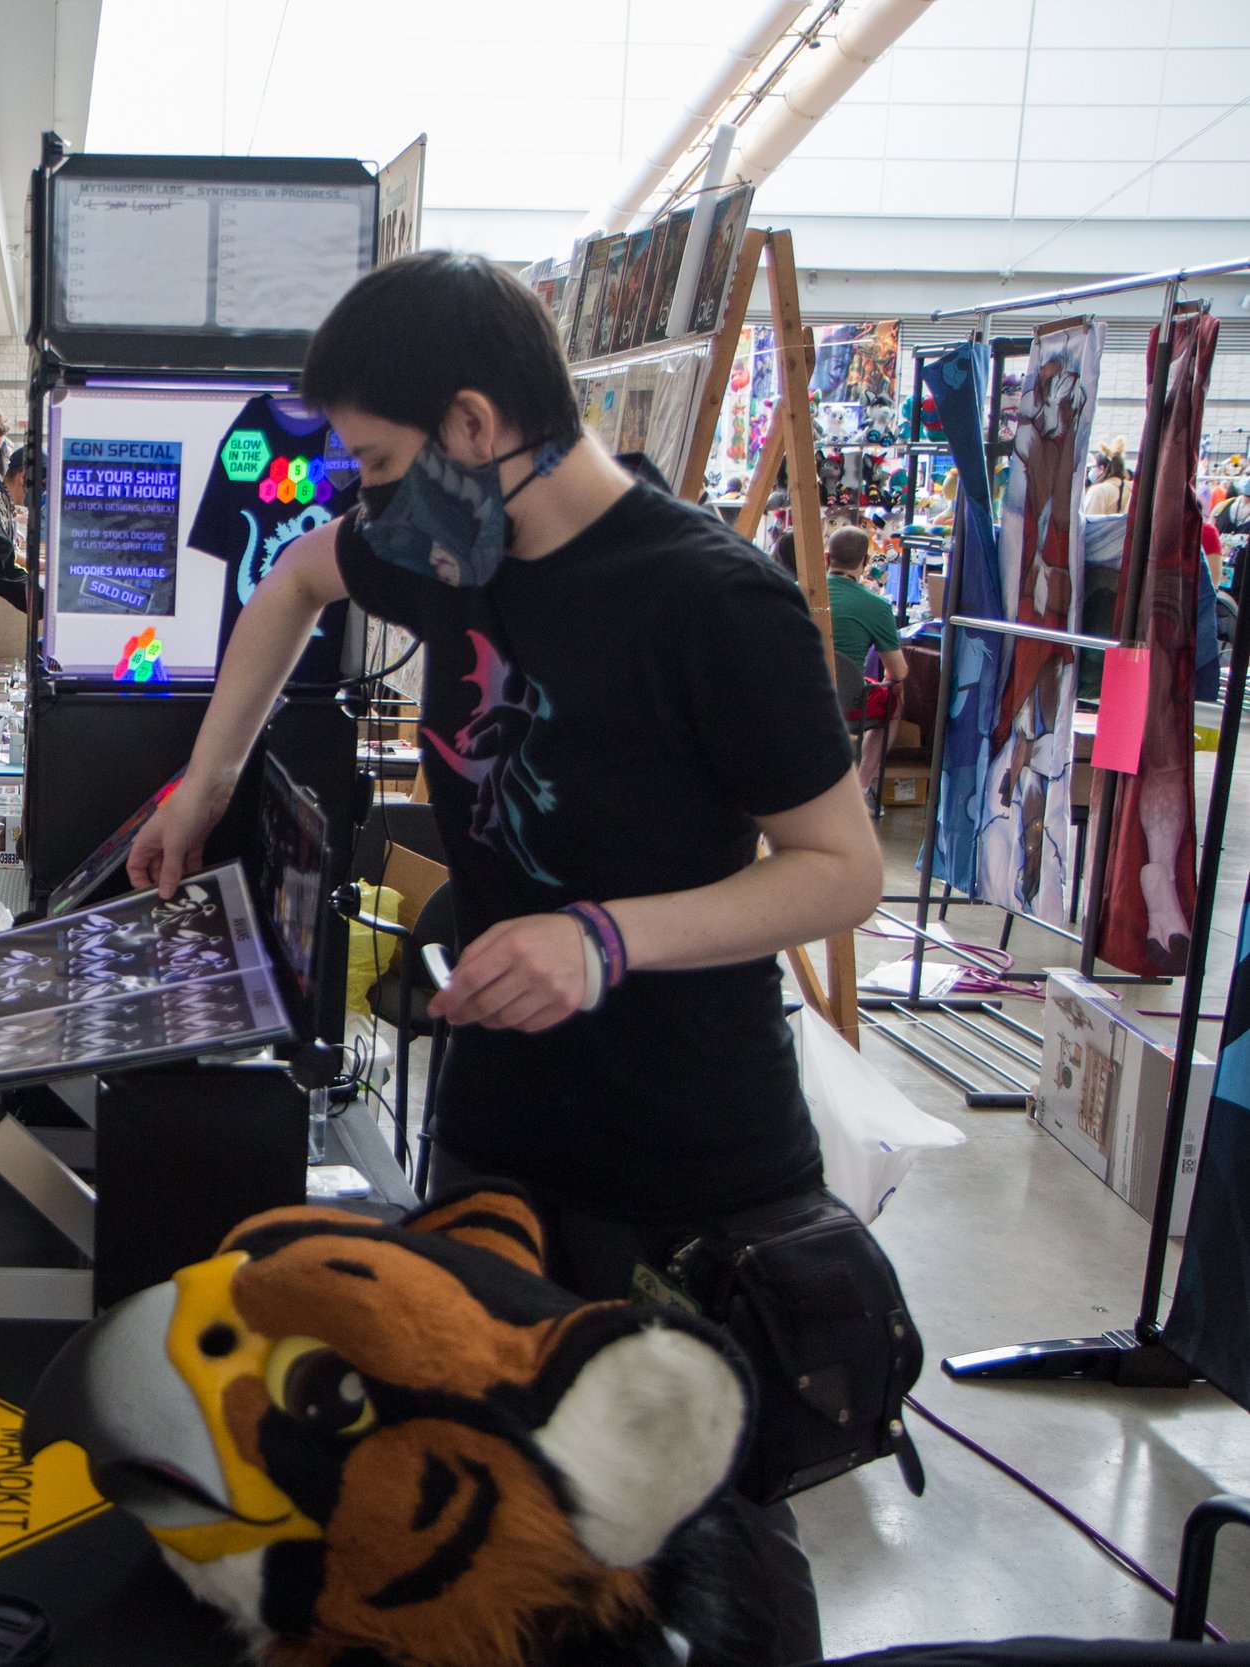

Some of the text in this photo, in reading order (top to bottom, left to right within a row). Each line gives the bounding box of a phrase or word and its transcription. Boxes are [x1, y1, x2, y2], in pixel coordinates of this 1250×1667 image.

[157, 185, 184, 195] LABS
[70, 442, 174, 459] CON SPECIAL
[230, 440, 262, 450] GLOW
[229, 451, 262, 461] IN THE
[230, 463, 258, 473] DARK
[66, 469, 176, 485] GET YOUR SHIRT
[65, 483, 175, 500] MADE IN 1 HOUR!
[77, 502, 103, 511] STOCK
[71, 529, 166, 541] OUT OF STOCK DESIGNS
[81, 541, 120, 550] CUSTOMS
[142, 543, 163, 552] FREE
[69, 565, 166, 578] HOODIES AVAILABLE
[90, 580, 145, 607] SOLD OUT
